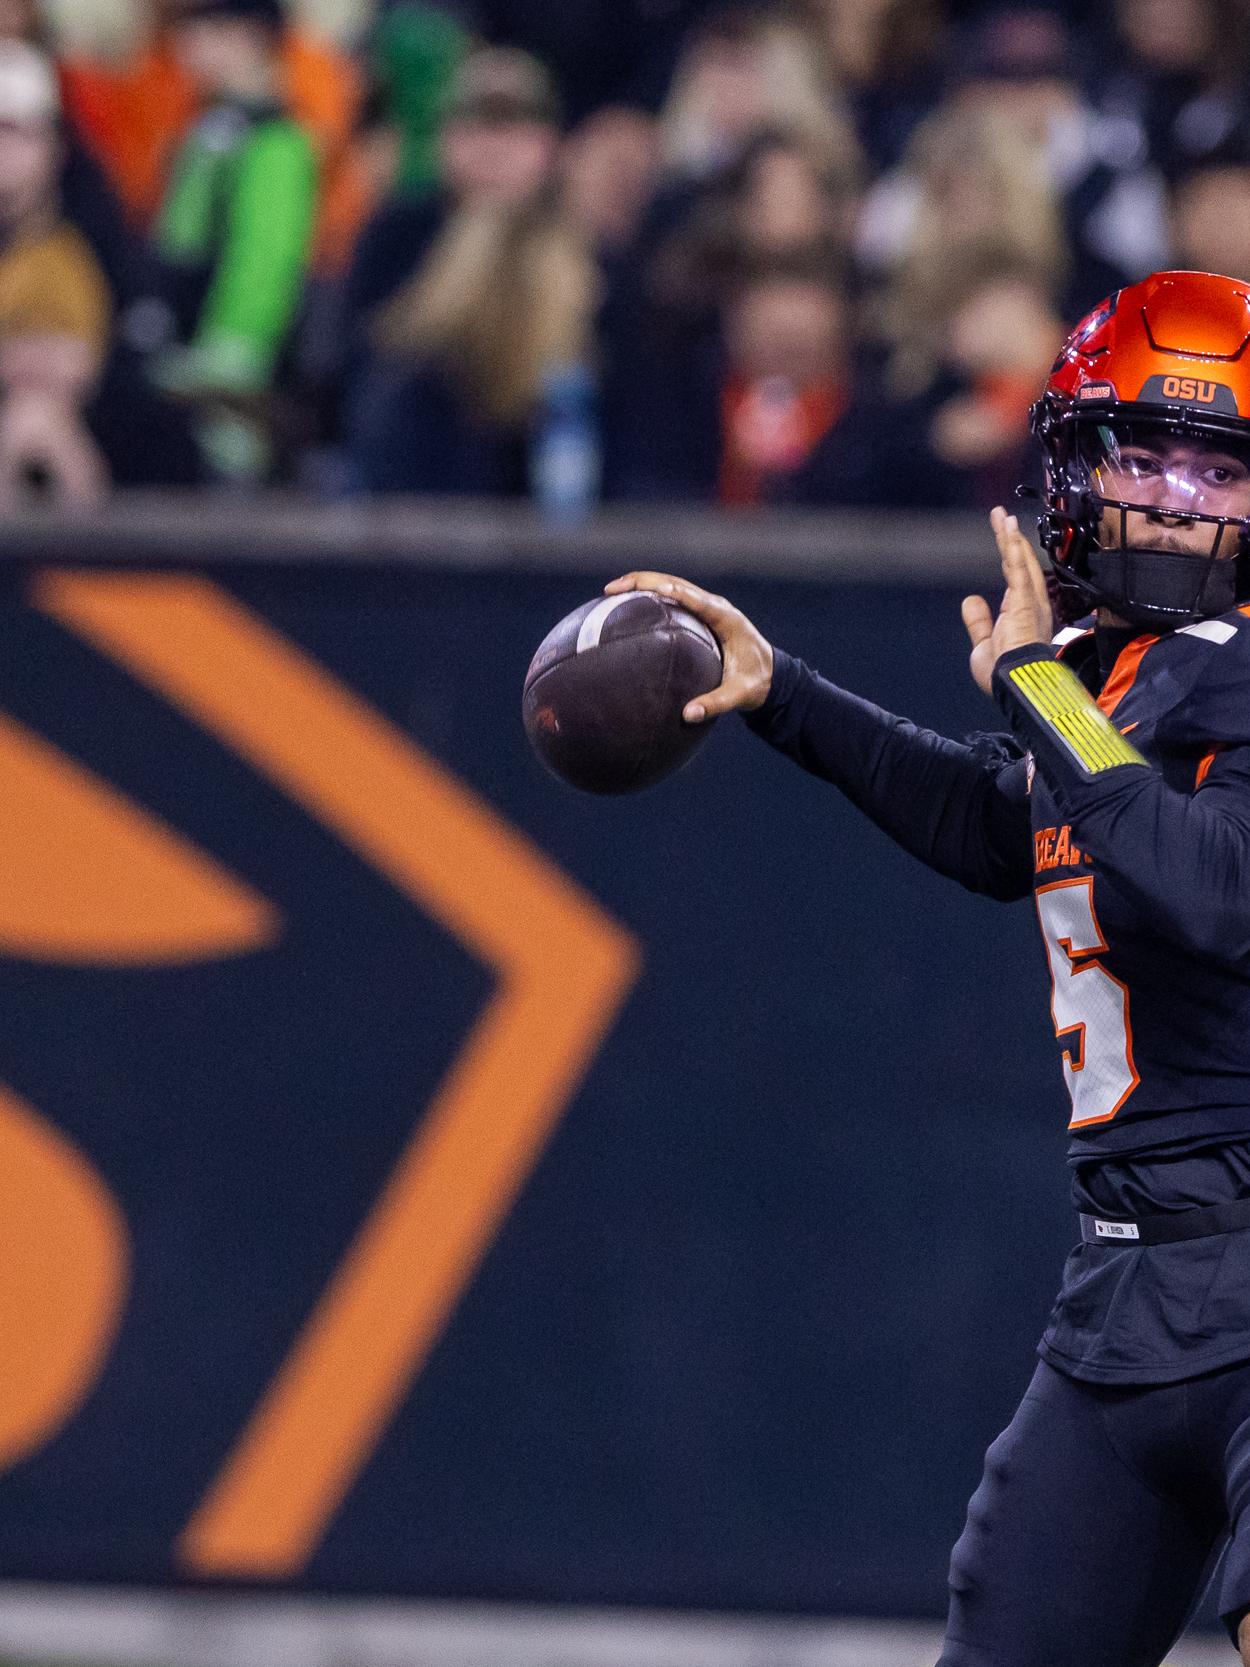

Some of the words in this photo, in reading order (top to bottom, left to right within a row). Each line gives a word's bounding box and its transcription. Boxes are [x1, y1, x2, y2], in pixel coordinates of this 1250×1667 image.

[1080, 386, 1110, 400] BEAVS
[1163, 376, 1217, 403] OSU
[1036, 876, 1141, 1130] 5
